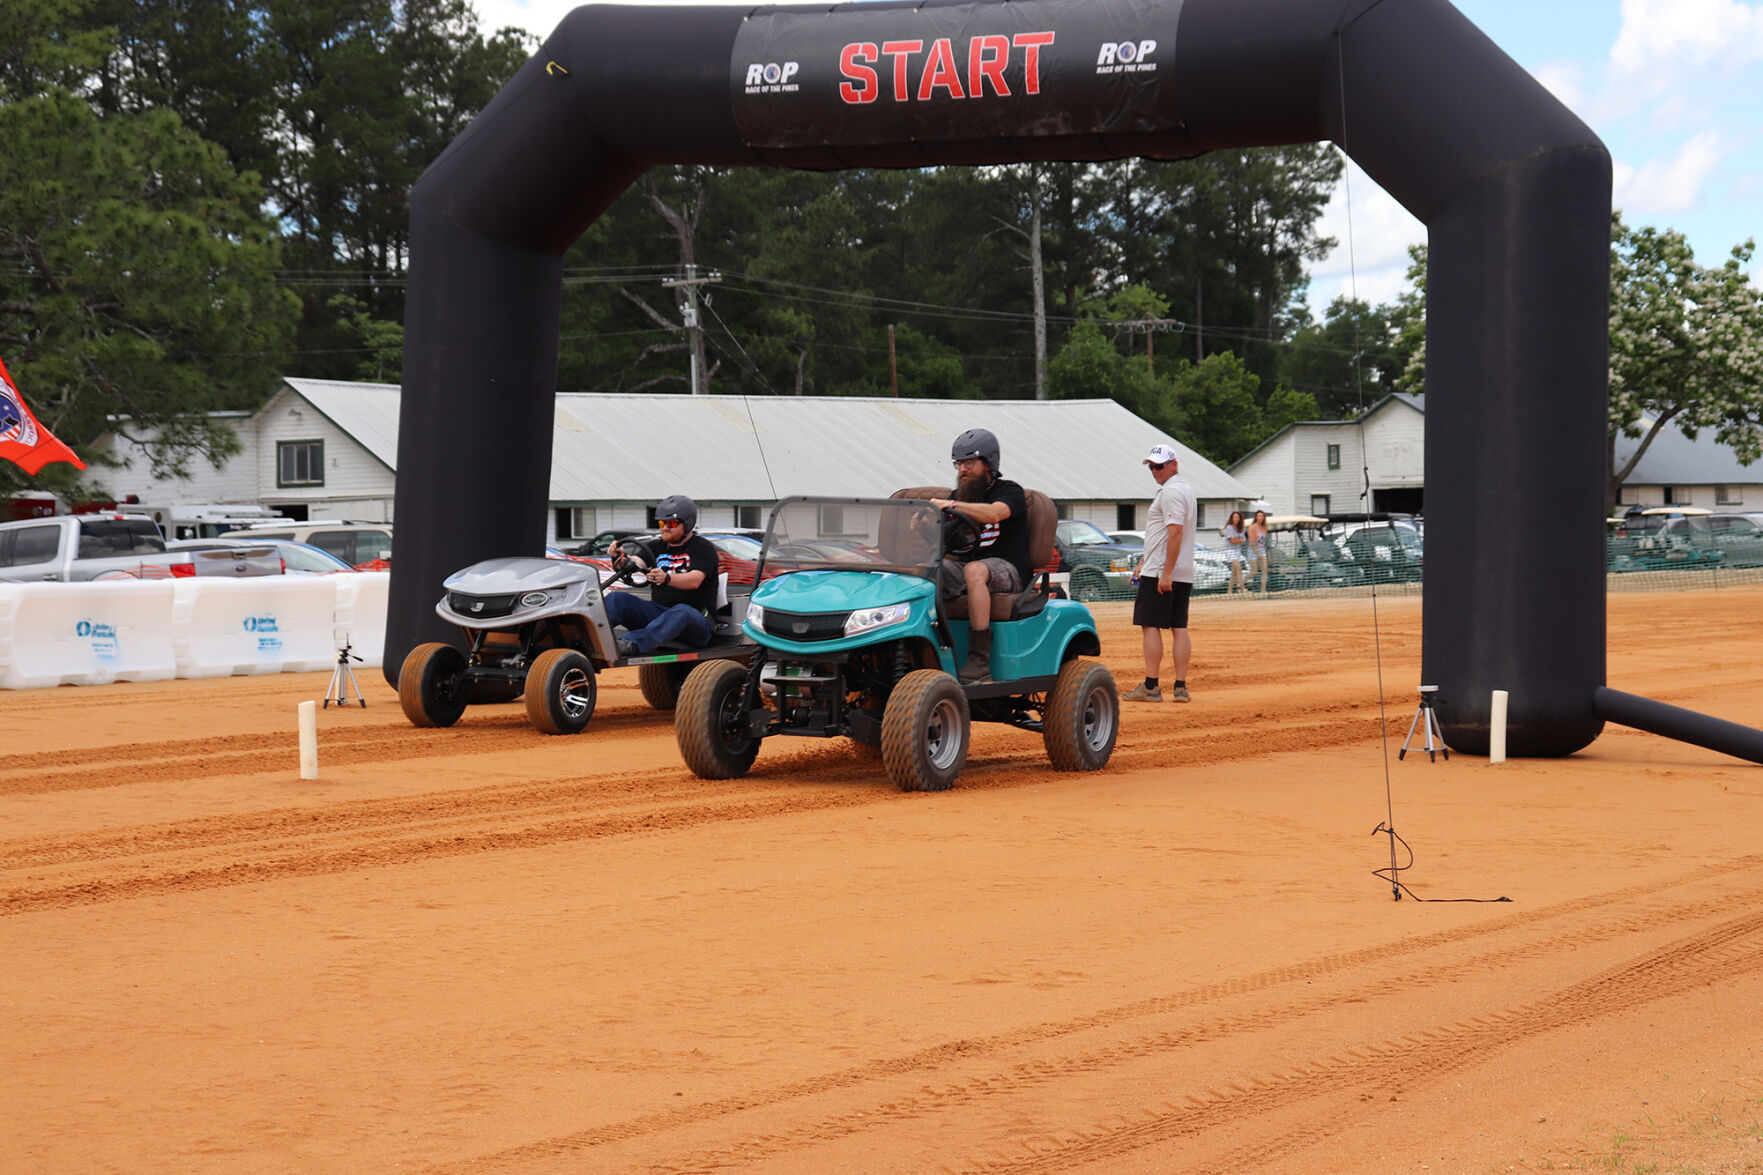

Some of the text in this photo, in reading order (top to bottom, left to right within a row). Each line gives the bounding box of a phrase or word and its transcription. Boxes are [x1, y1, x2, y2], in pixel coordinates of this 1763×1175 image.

[1097, 40, 1157, 65] ROP
[745, 62, 799, 85] ROP
[839, 31, 1055, 104] START
[1096, 66, 1114, 74] RACE
[1114, 65, 1123, 73] OF
[1124, 64, 1137, 72] THE
